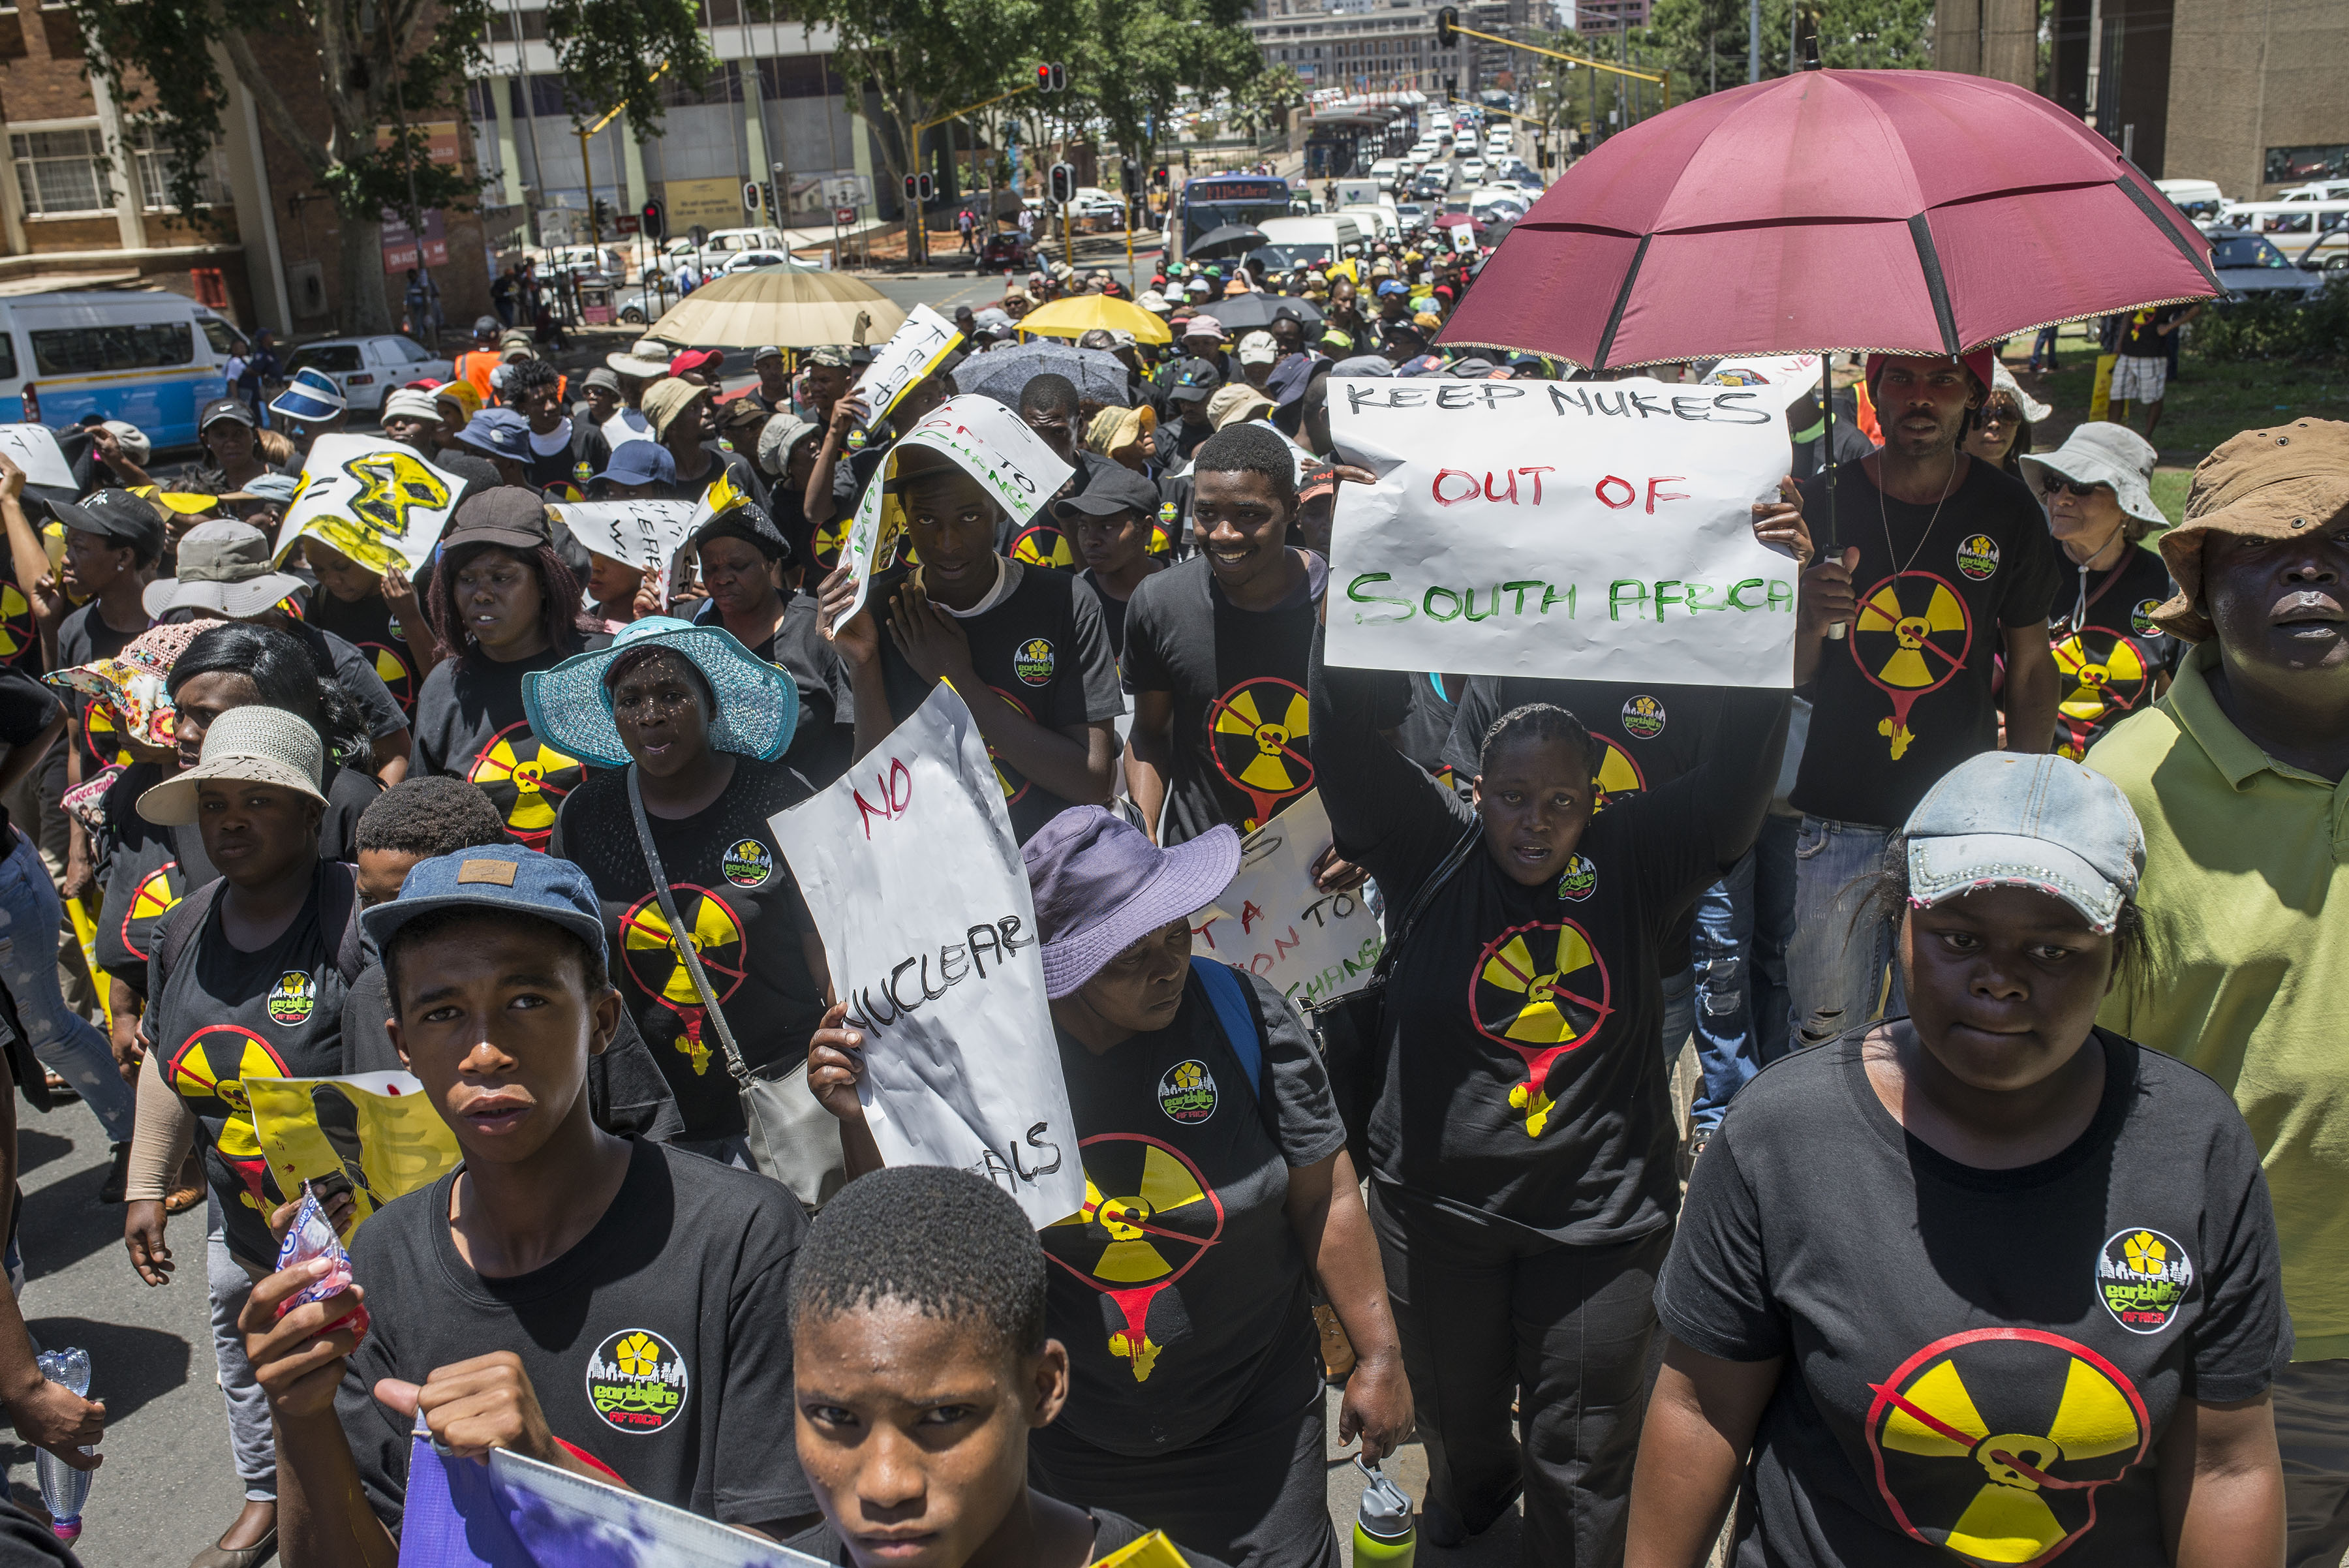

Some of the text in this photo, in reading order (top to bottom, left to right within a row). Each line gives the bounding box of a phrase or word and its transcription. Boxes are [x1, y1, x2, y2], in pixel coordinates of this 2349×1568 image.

[1347, 384, 1771, 424] KEEP NUKES
[1432, 467, 1691, 515] OUT OF
[1347, 572, 1793, 625] SOUTH AFRICA
[854, 757, 912, 841] NO
[1242, 900, 1265, 936] A
[1301, 893, 1356, 928] TO
[843, 915, 1035, 1053] NUCLEAR
[962, 1115, 1062, 1195] ALS
[2105, 1280, 2181, 1304] earthlife
[2123, 1311, 2165, 1323] AFRICA
[594, 1381, 679, 1407] earthlife
[609, 1411, 662, 1426] AFRICA
